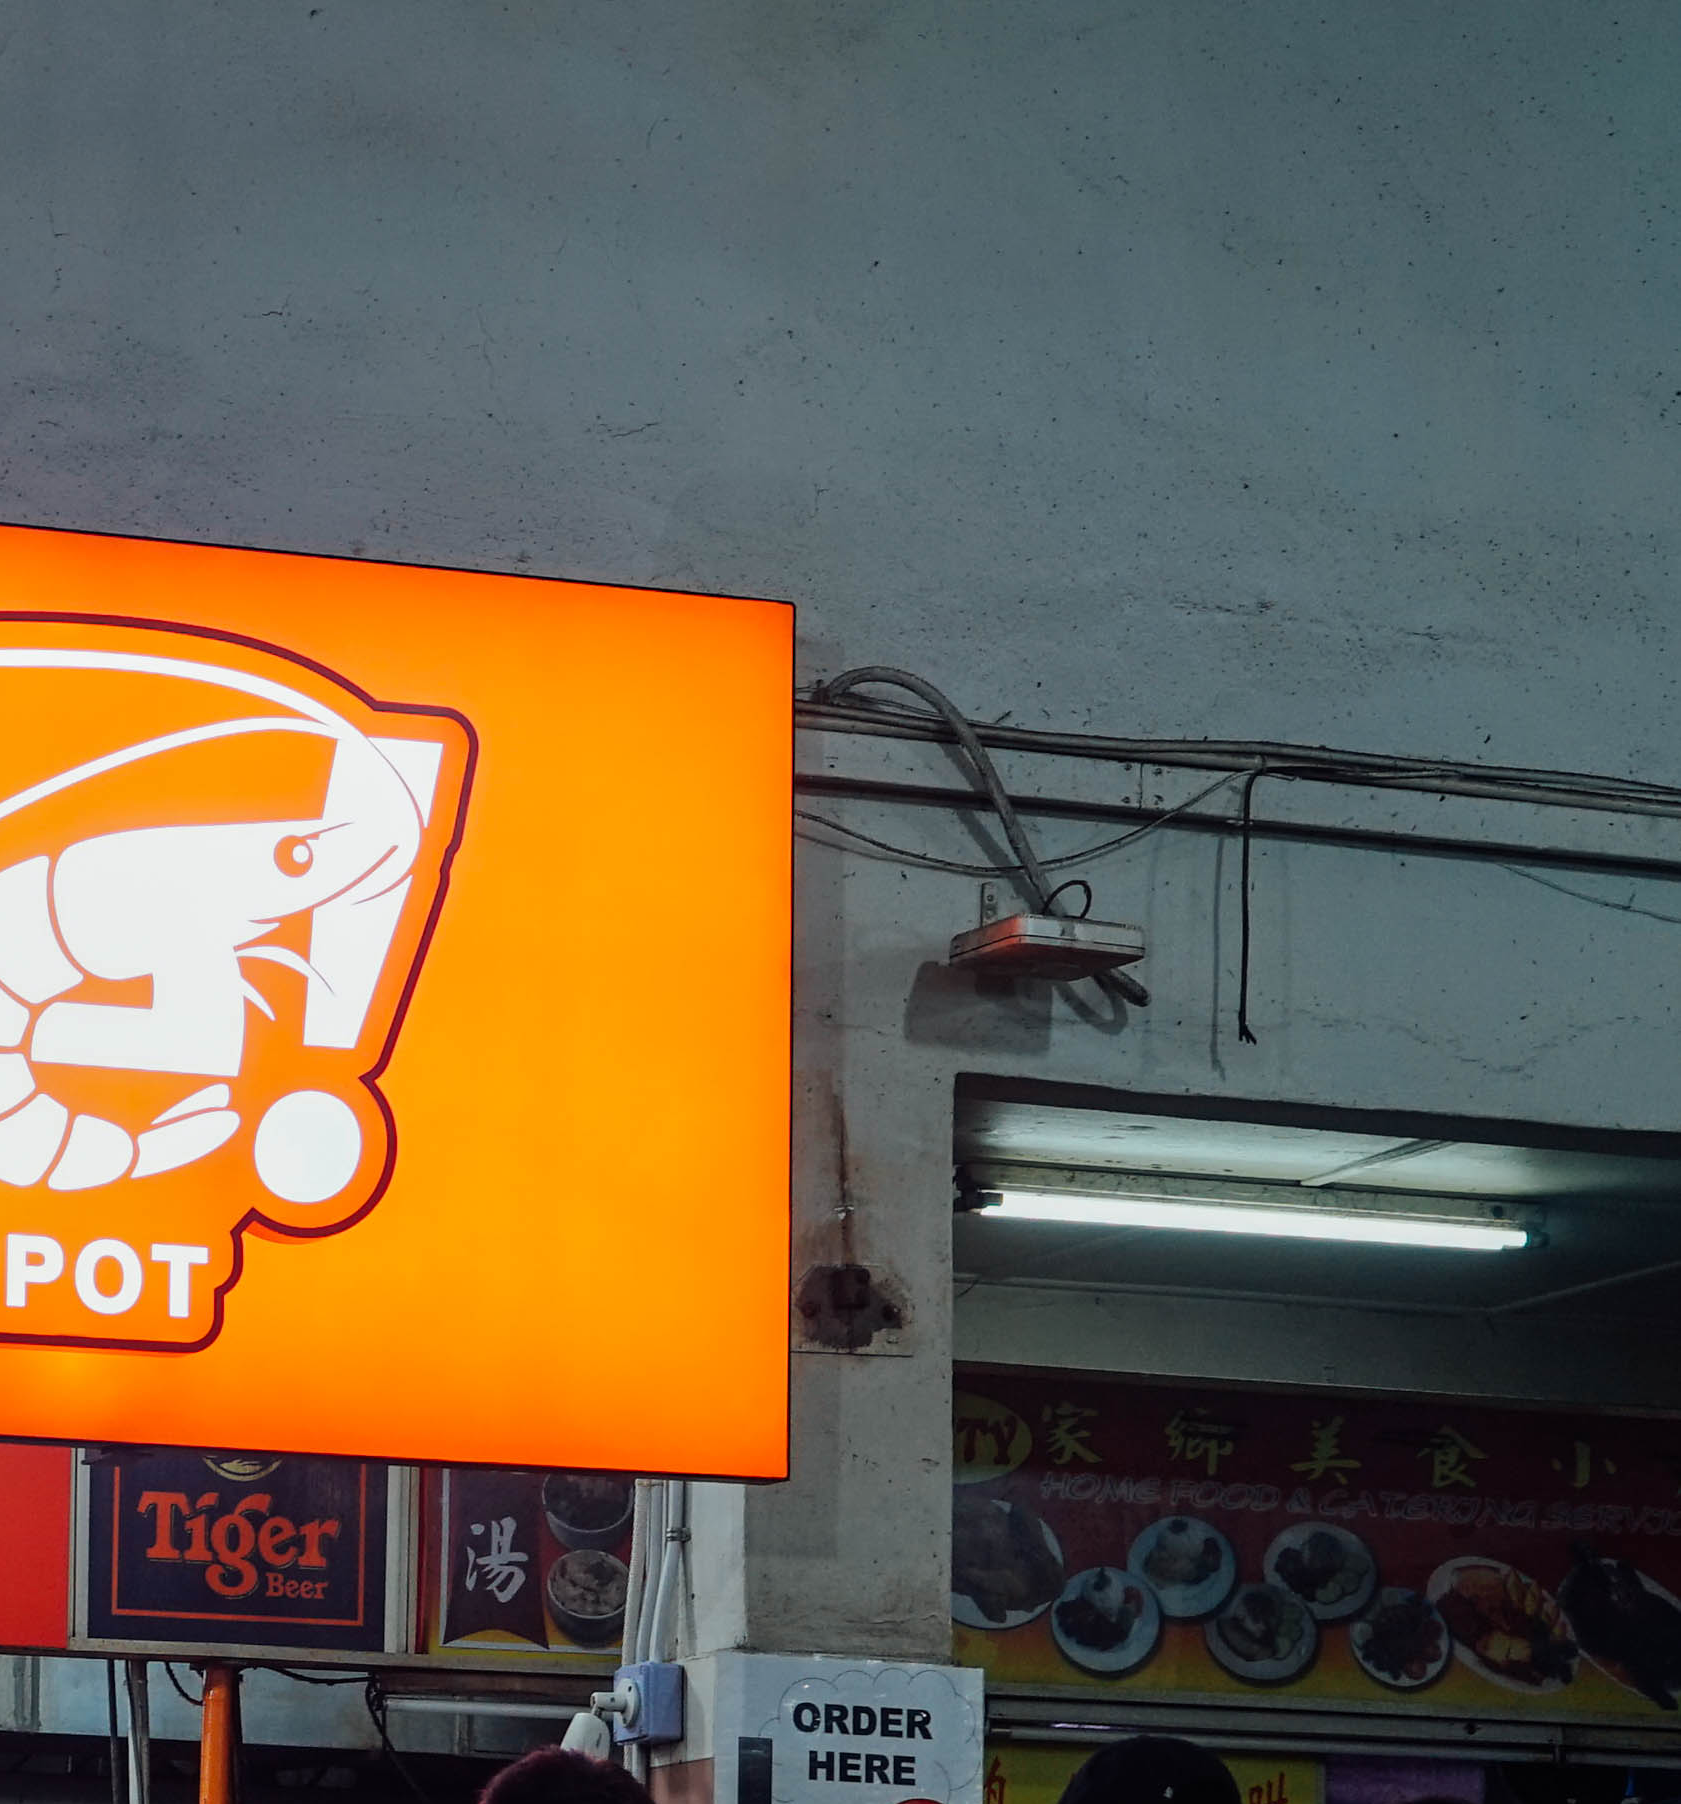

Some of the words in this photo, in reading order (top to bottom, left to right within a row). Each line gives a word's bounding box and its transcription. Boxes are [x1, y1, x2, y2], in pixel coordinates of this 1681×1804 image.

[1040, 1471, 1161, 1505] HOME
[1169, 1479, 1283, 1511] FOOD
[1318, 1488, 1536, 1529] CATERING
[136, 1490, 341, 1600] Tiger
[463, 1515, 530, 1605] 湯
[264, 1571, 330, 1600] Beer
[792, 1702, 933, 1740] ORDER
[807, 1749, 917, 1787] HERE
